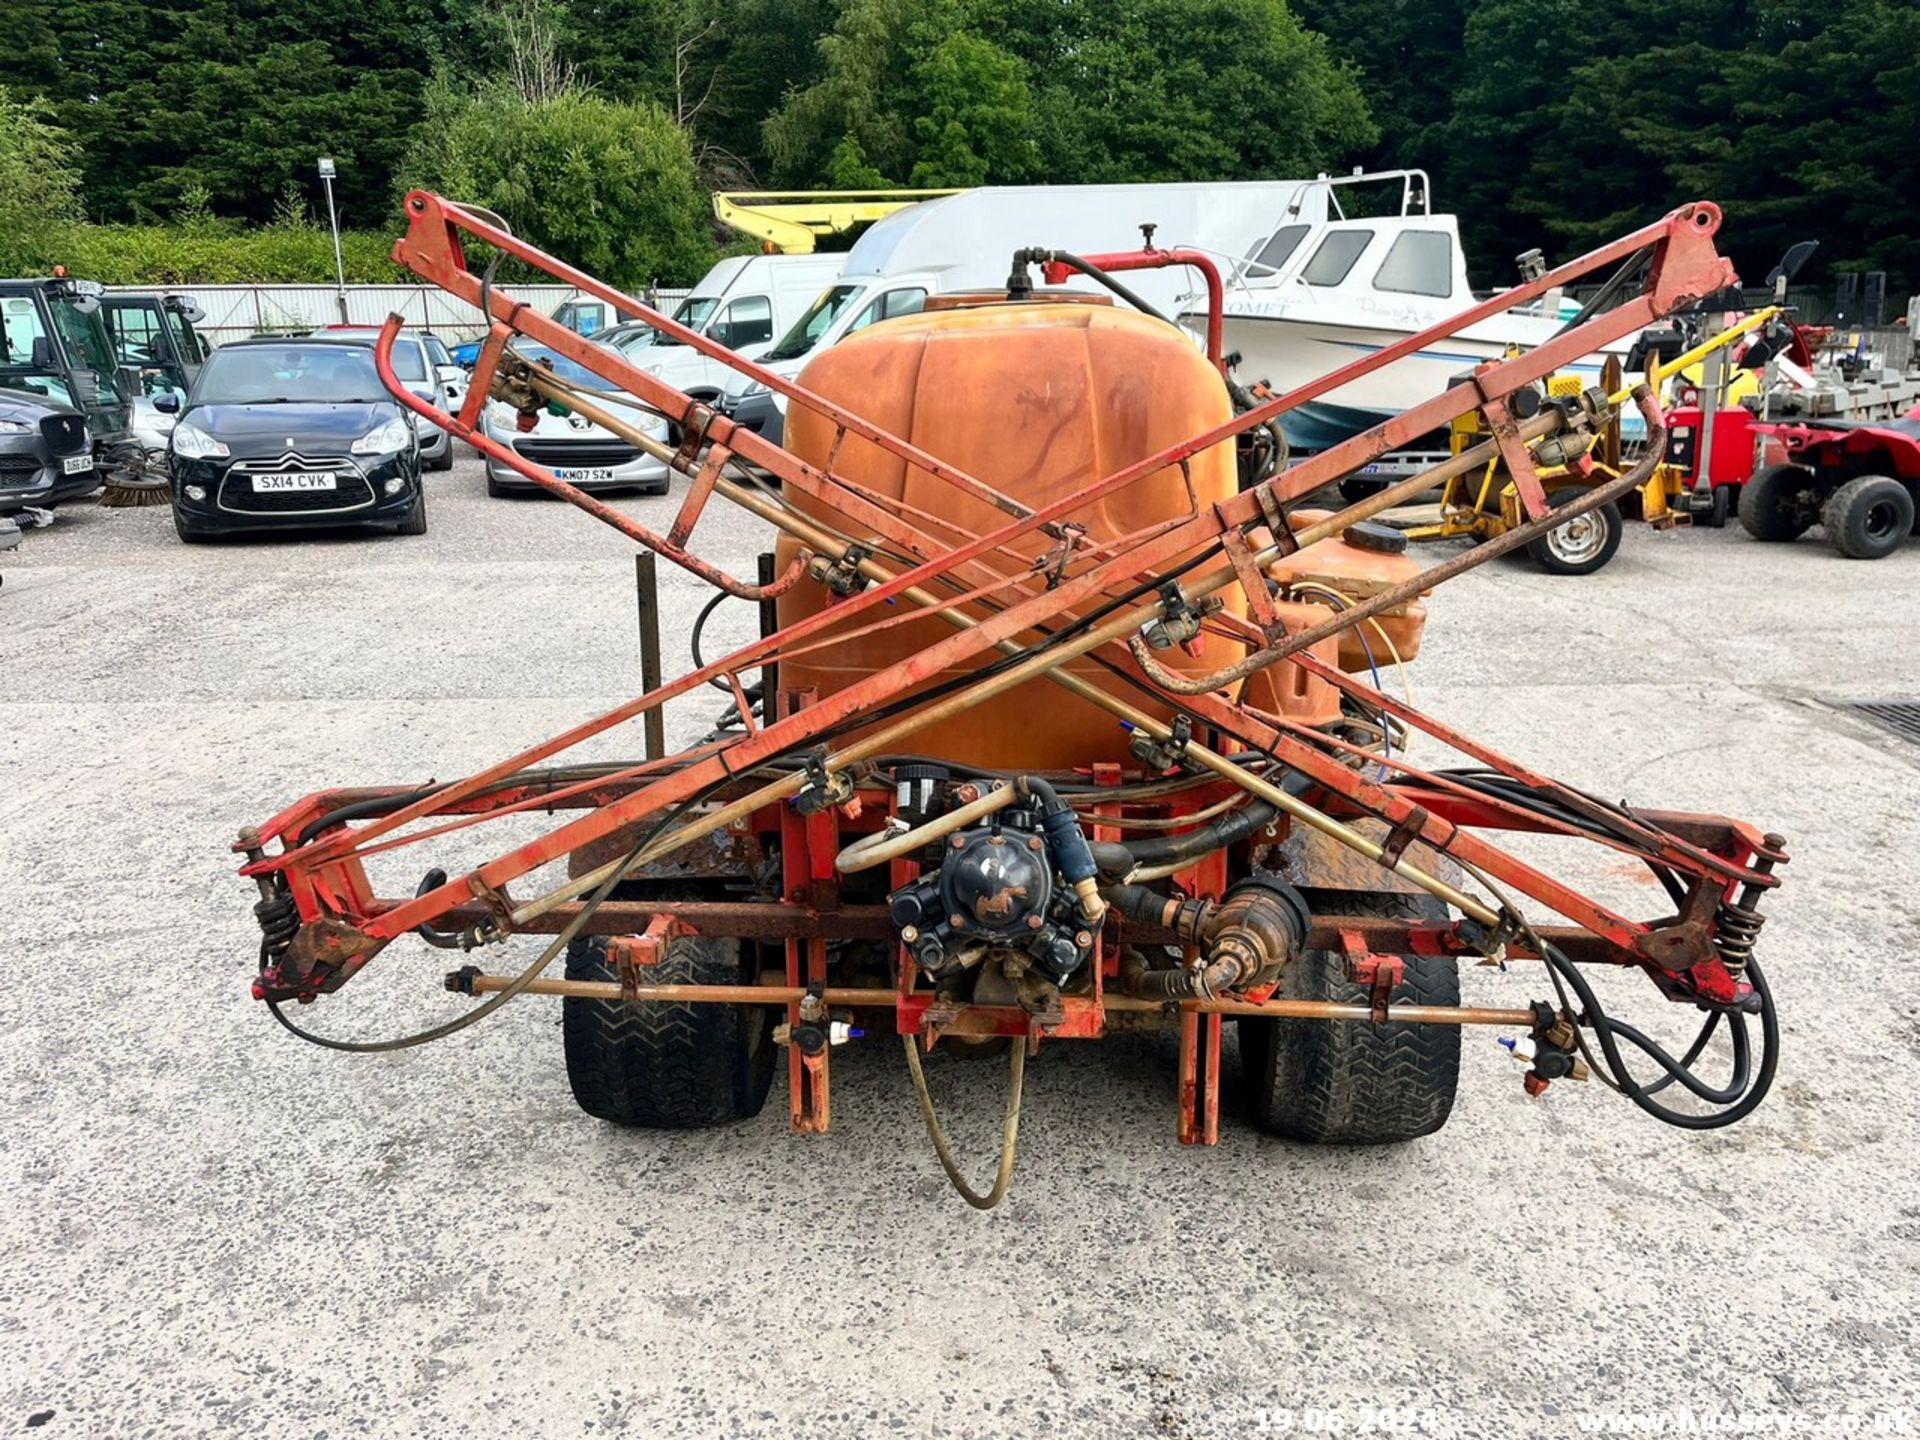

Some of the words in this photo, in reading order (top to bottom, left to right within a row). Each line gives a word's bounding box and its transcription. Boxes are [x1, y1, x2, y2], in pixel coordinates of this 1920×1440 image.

[1226, 301, 1291, 316] OMET
[260, 475, 293, 489] SX14
[297, 474, 327, 488] CVK
[562, 469, 590, 481] KM07
[592, 469, 613, 480] SZW
